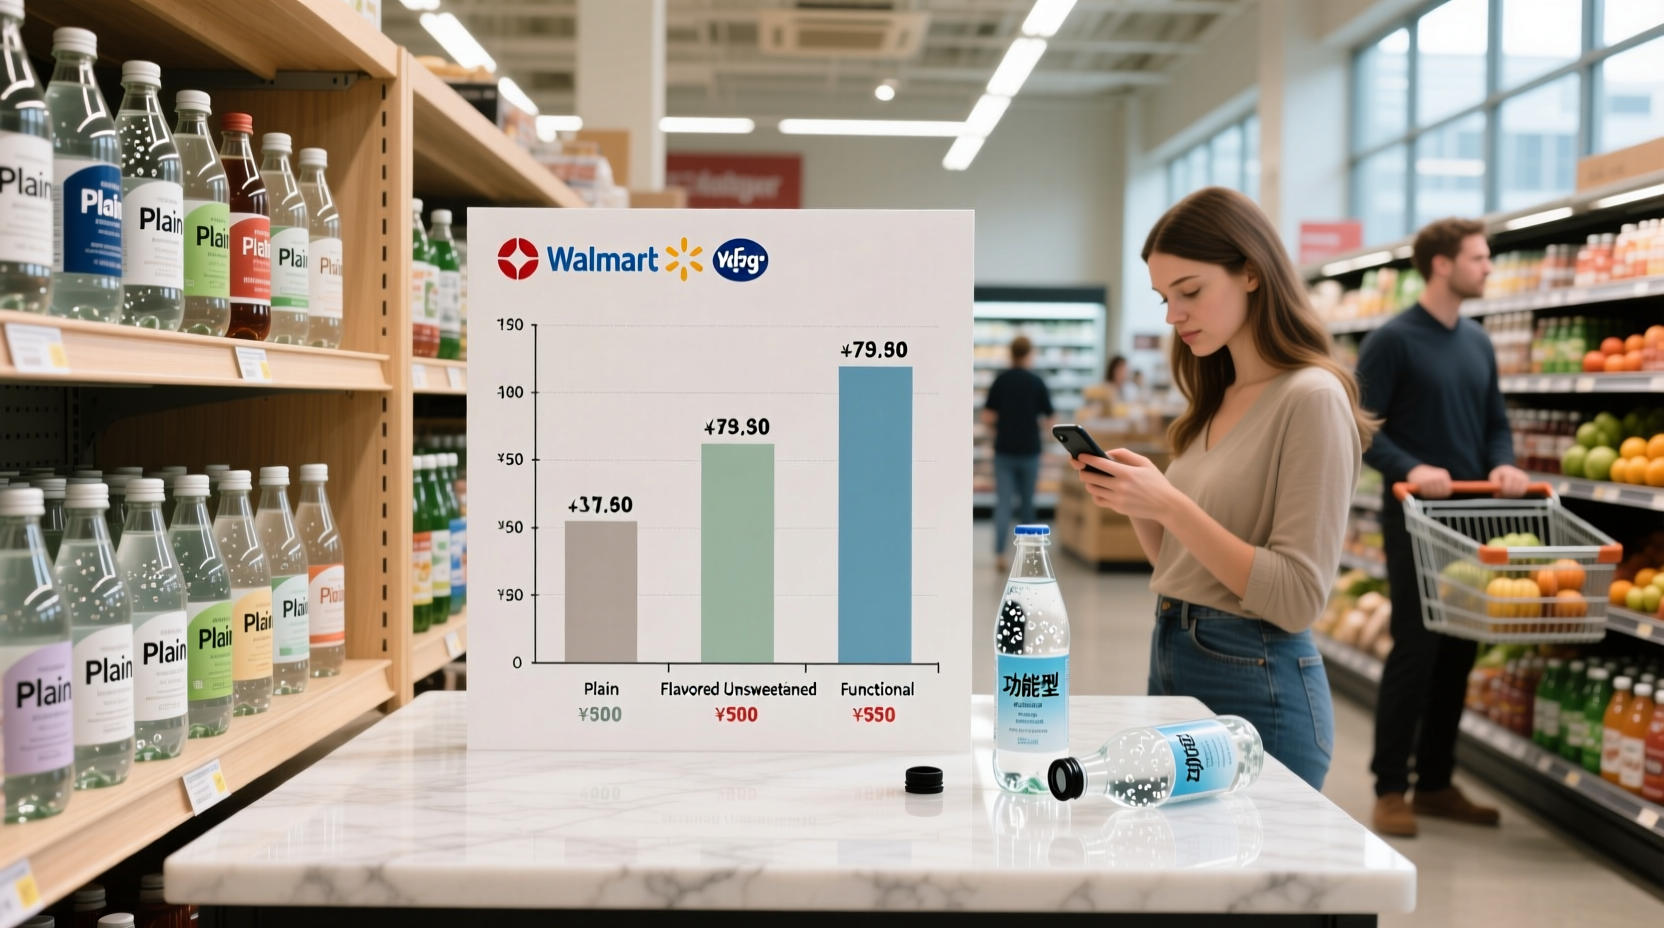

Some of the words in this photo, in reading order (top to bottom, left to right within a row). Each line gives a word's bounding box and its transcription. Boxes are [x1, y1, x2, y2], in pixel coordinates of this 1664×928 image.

[140, 207, 183, 235] Plain
[547, 246, 659, 272] Walmart
[497, 453, 523, 465] ¥50
[143, 638, 187, 665] Plain
[86, 655, 133, 685] Plain
[513, 656, 522, 669] 0
[584, 681, 619, 695] Plain
[661, 681, 720, 696] Flavored
[841, 681, 914, 696] Functional
[1003, 671, 1060, 697] 功能型
[16, 676, 72, 709] Plain
[578, 706, 622, 722] ¥500
[714, 706, 759, 722] ¥500
[852, 706, 896, 722] ¥550
